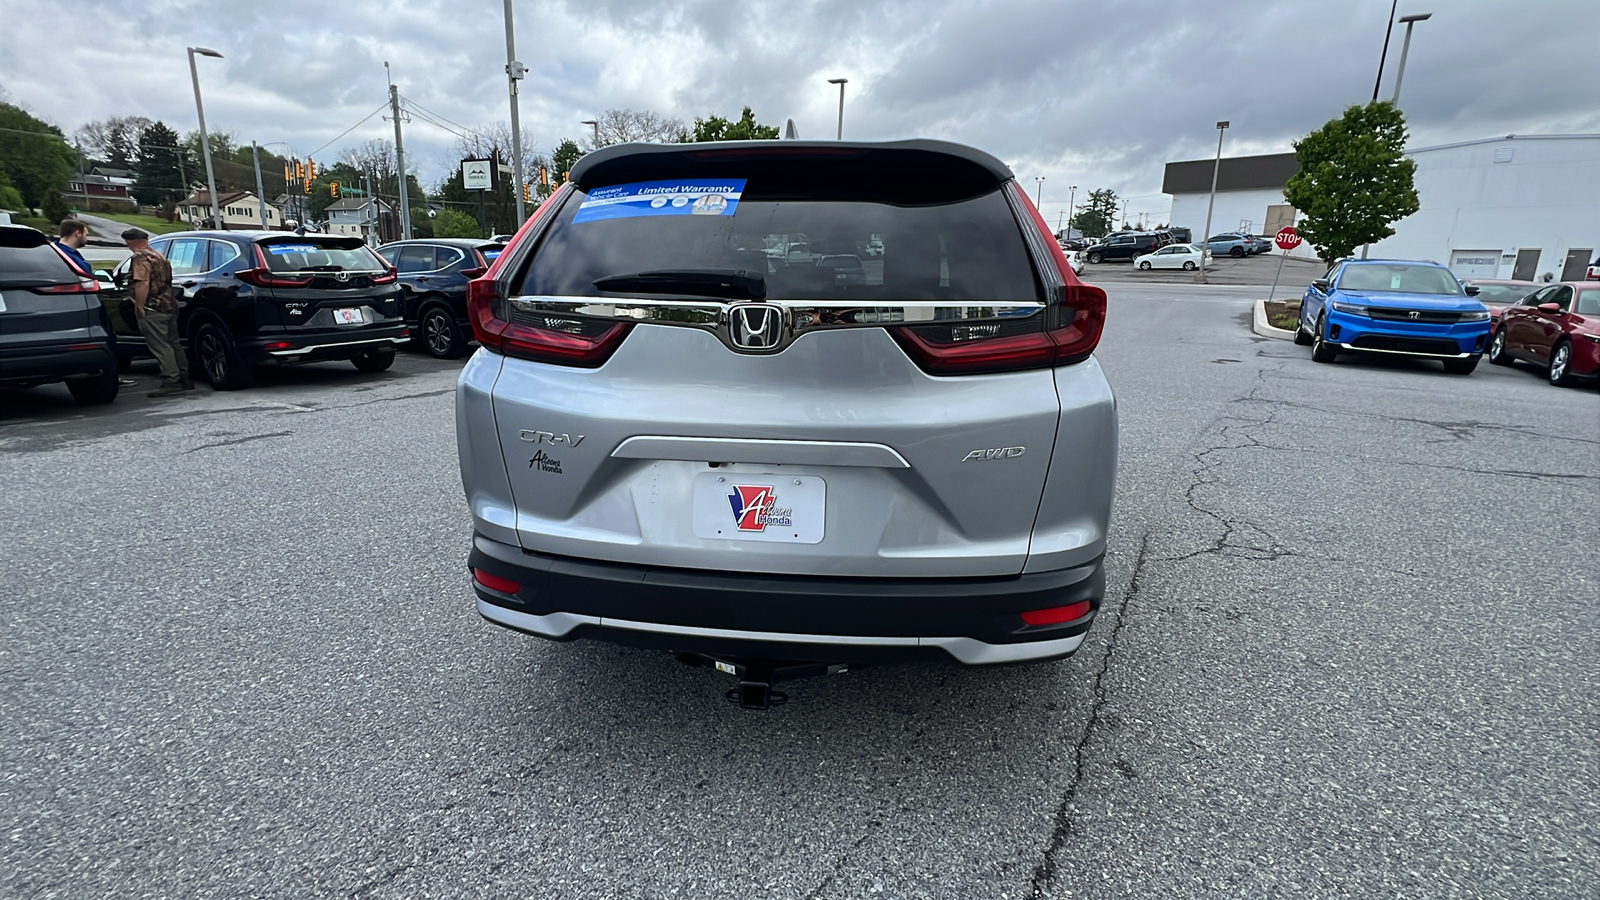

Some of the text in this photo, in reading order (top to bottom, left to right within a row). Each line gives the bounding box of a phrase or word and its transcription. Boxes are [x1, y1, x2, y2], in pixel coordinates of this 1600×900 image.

[591, 187, 623, 196] Assurant
[637, 185, 735, 195] Limited Warranty
[518, 429, 586, 448] CR-V
[529, 449, 561, 471] Altoona
[961, 445, 1026, 462] AWD
[542, 464, 563, 474] Honda
[738, 490, 792, 525] Altoona
[759, 514, 792, 526] Honda
